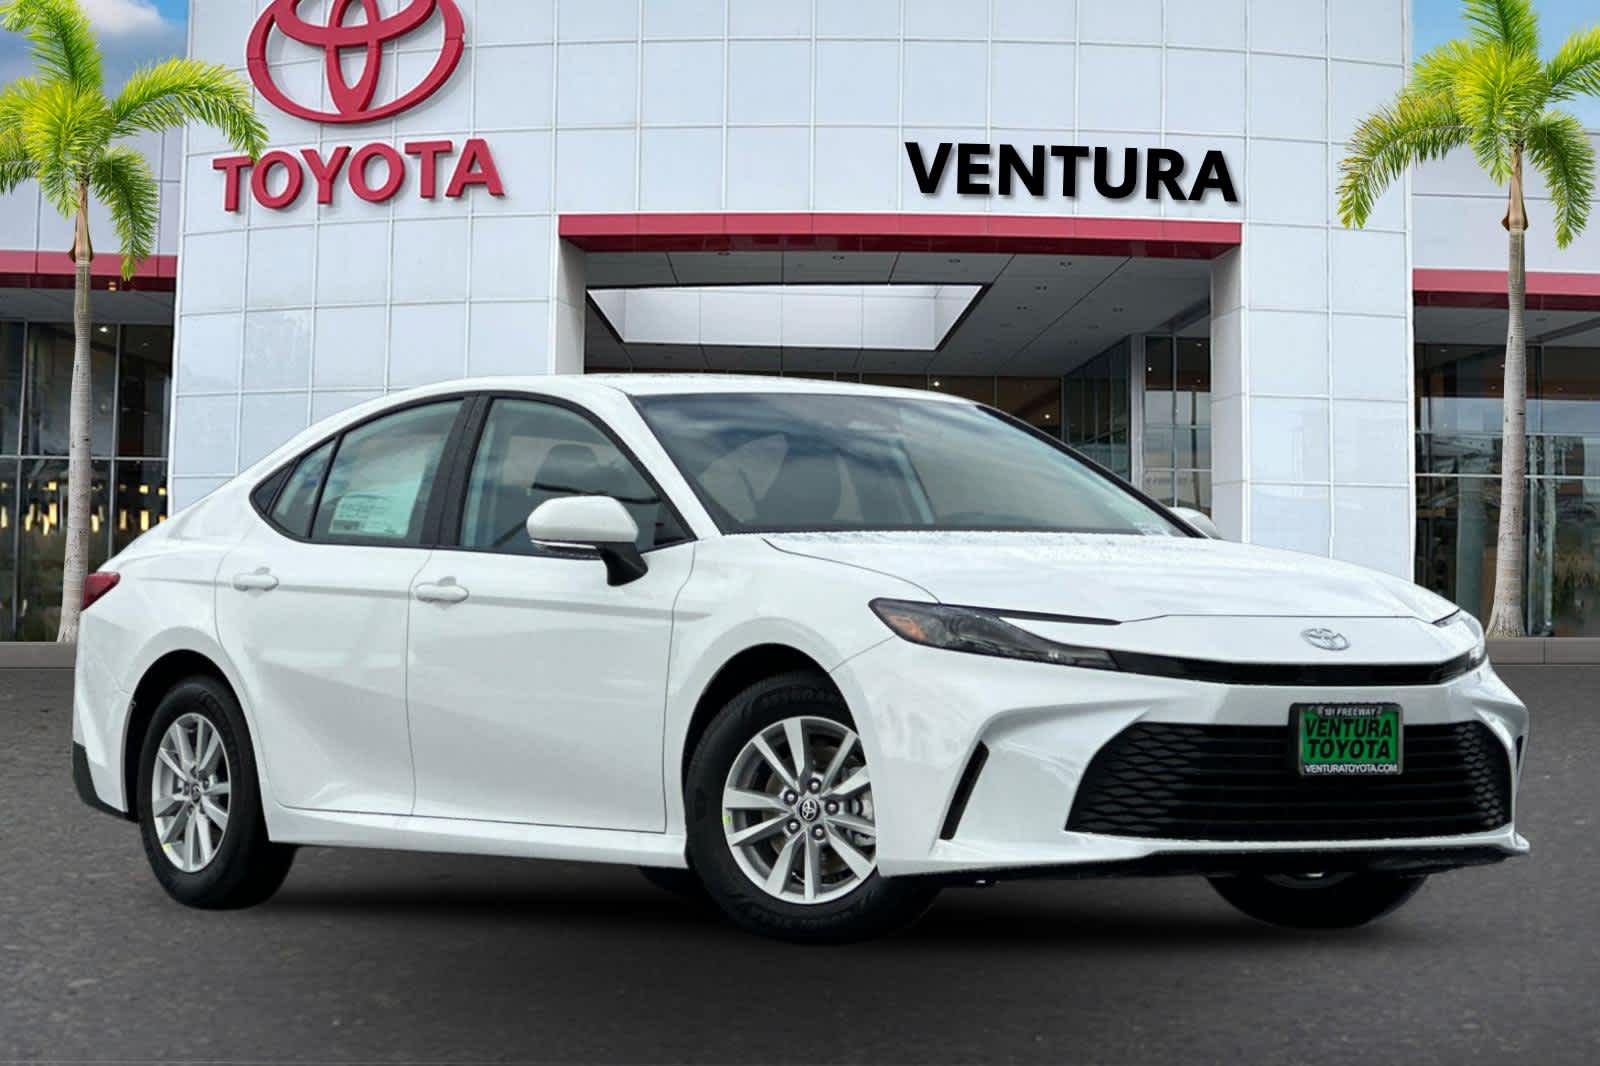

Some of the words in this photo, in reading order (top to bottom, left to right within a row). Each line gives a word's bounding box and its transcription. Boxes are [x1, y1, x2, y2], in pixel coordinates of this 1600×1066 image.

[212, 138, 505, 212] TOYOTA
[904, 142, 1239, 203] VENTURA
[1337, 708, 1376, 716] FREEWAY
[1305, 718, 1393, 737] VENTURA
[1308, 739, 1391, 759] TOYOTA
[1305, 764, 1398, 774] VENTURATOYOTA.COM
